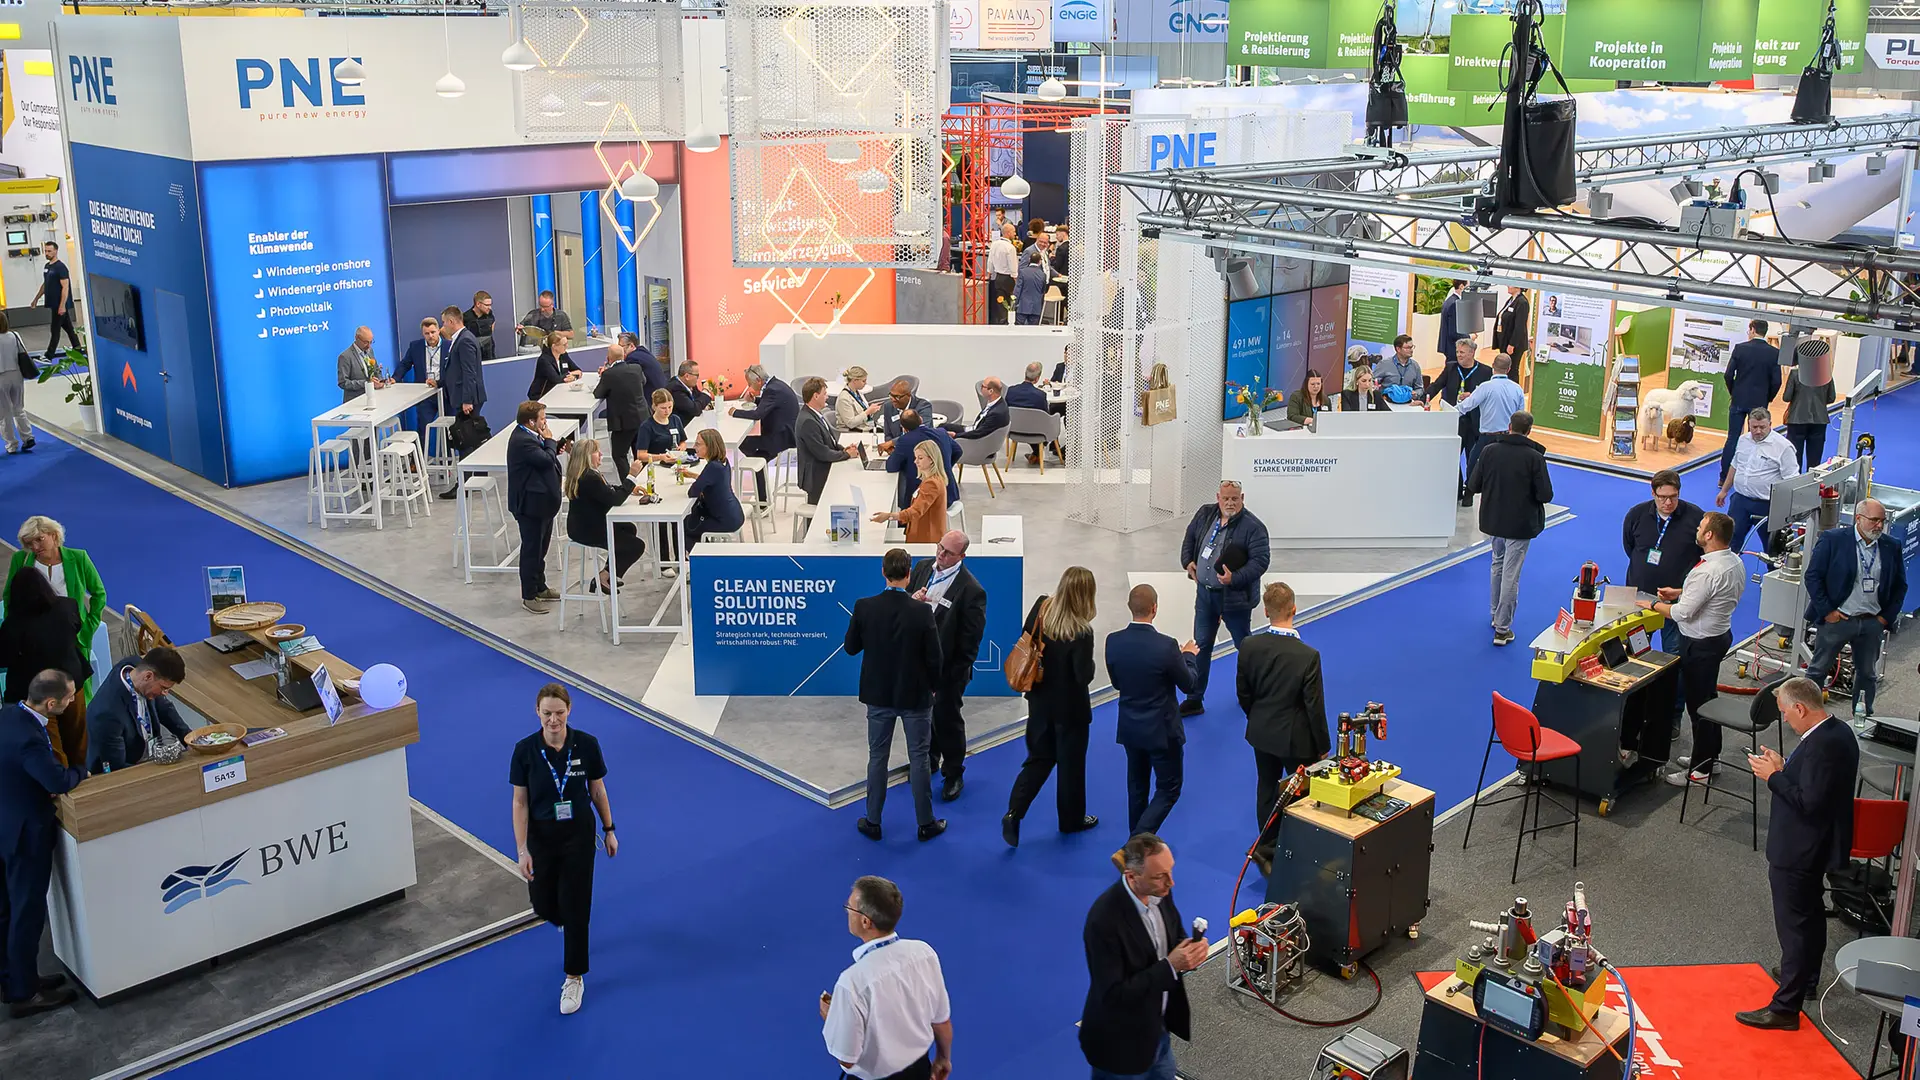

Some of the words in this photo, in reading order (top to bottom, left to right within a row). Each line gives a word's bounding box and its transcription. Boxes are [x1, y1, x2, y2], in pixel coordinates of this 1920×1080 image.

[988, 8, 1030, 20] PAVANA
[1244, 31, 1309, 46] Projektierung
[1755, 39, 1779, 51] keit
[1781, 42, 1800, 51] zur
[1241, 45, 1249, 55] &
[1251, 44, 1310, 59] Realisierung
[1337, 47, 1343, 57] &
[1595, 41, 1648, 56] Projekte
[1651, 41, 1664, 54] in
[1711, 42, 1735, 57] Projekte
[1736, 42, 1742, 54] in
[1886, 39, 1920, 56] PL
[1589, 56, 1667, 71] Kooperation
[1708, 57, 1743, 72] Kooperation
[1753, 53, 1787, 66] igung
[1885, 57, 1920, 66] Torque
[69, 55, 117, 105] PNE
[236, 57, 366, 109] PNE
[21, 100, 30, 111] Our
[1406, 93, 1456, 106] bsführung
[23, 115, 32, 126] Our
[260, 112, 288, 122] pure
[295, 111, 319, 119] new
[325, 109, 367, 119] energy
[1151, 132, 1216, 170] PNE
[88, 200, 101, 216] DIE
[101, 202, 156, 229] ENERGIEWENDE
[91, 218, 122, 240] BRAUCHT
[122, 225, 143, 246] DICH!
[248, 231, 289, 244] Enabler
[291, 230, 309, 240] der
[249, 240, 314, 255] Klimawende
[266, 262, 330, 277] Windenergie
[332, 259, 371, 272] onshore
[268, 281, 331, 297] Windenergie
[333, 278, 373, 291] offshore
[743, 275, 802, 295] Services
[270, 301, 333, 317] Photovoltaik
[272, 320, 329, 337] Power-to-X
[1324, 322, 1336, 332] GW
[1232, 338, 1246, 350] 491
[1248, 335, 1261, 347] MW
[1564, 371, 1574, 380] 15
[1558, 387, 1577, 397] 1000
[1155, 399, 1170, 410] PNE
[1559, 404, 1574, 413] 200
[1282, 464, 1331, 472] VERBÜNDETE!
[714, 579, 767, 593] CLEAN
[771, 579, 836, 593] ENERGY
[714, 595, 807, 609] SOLUTIONS
[715, 612, 797, 625] PROVIDER
[715, 631, 751, 639] Strategisch
[751, 631, 770, 639] stark,
[801, 631, 828, 639] versiert,
[214, 770, 236, 783] 5A13
[258, 821, 348, 877] BWE
